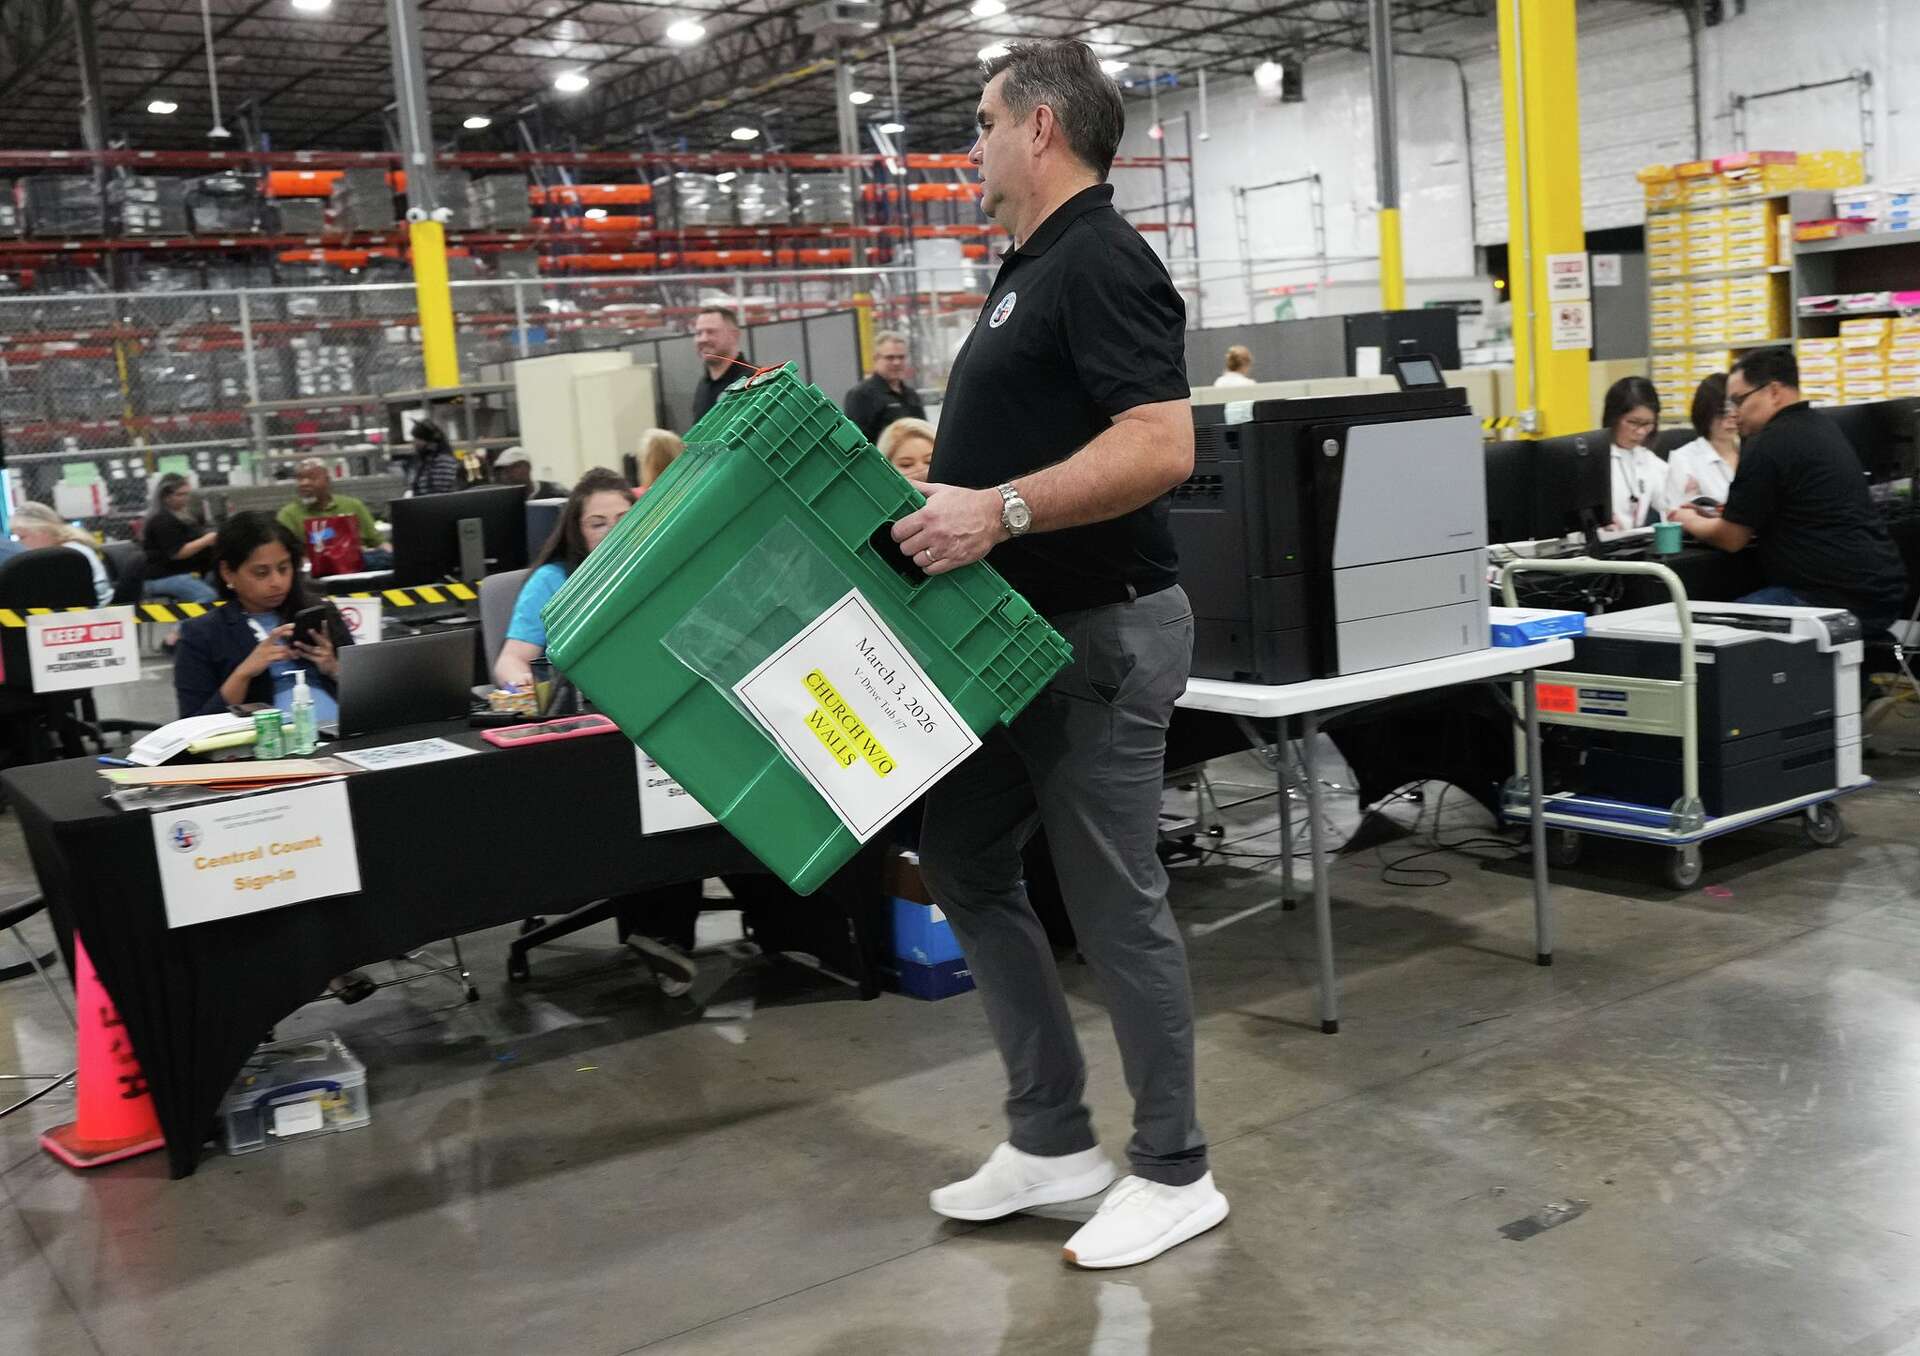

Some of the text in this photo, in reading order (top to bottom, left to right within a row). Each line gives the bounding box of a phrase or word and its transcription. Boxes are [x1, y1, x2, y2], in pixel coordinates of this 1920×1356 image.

[43, 622, 122, 645] KEEP OUT
[853, 667, 908, 731] V-Drive Tub #7
[855, 637, 939, 735] March 3, 2026
[805, 672, 894, 776] CHURCH W/O
[810, 709, 857, 767] WALLS
[194, 836, 322, 870] Central Count
[235, 869, 296, 890] Sign-in
